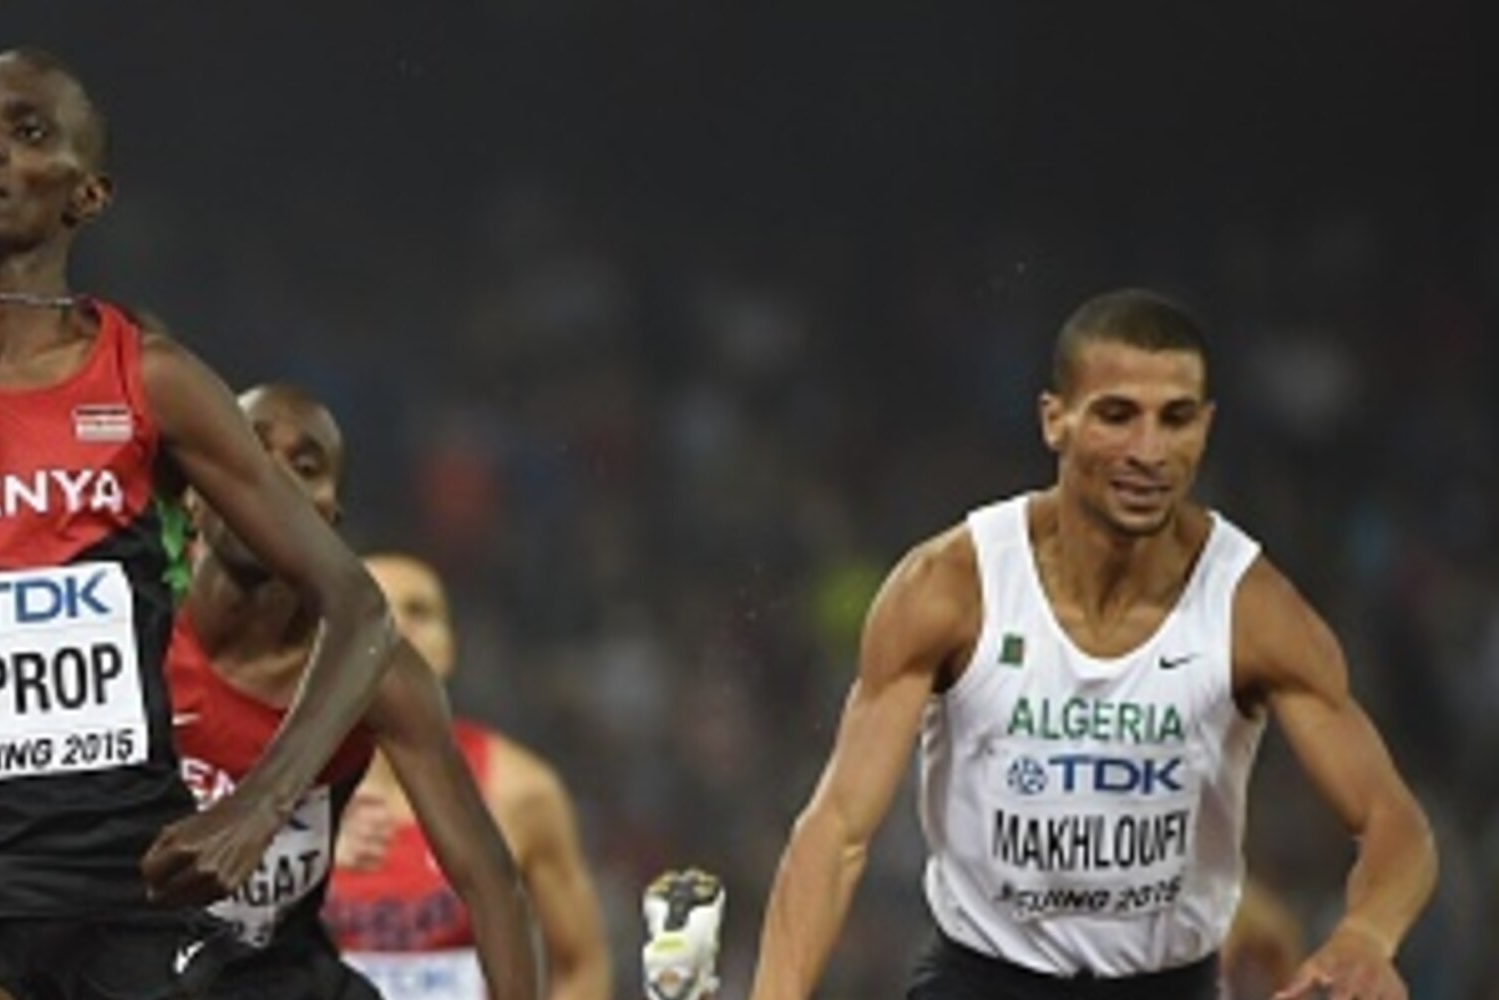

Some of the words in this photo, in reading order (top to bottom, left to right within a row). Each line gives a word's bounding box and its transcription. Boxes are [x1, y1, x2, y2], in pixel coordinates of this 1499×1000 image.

[1007, 697, 1187, 743] ALGERIA
[60, 728, 136, 766] 2015
[1048, 755, 1183, 794] TDK
[992, 810, 1190, 871] MAKHLOUFI
